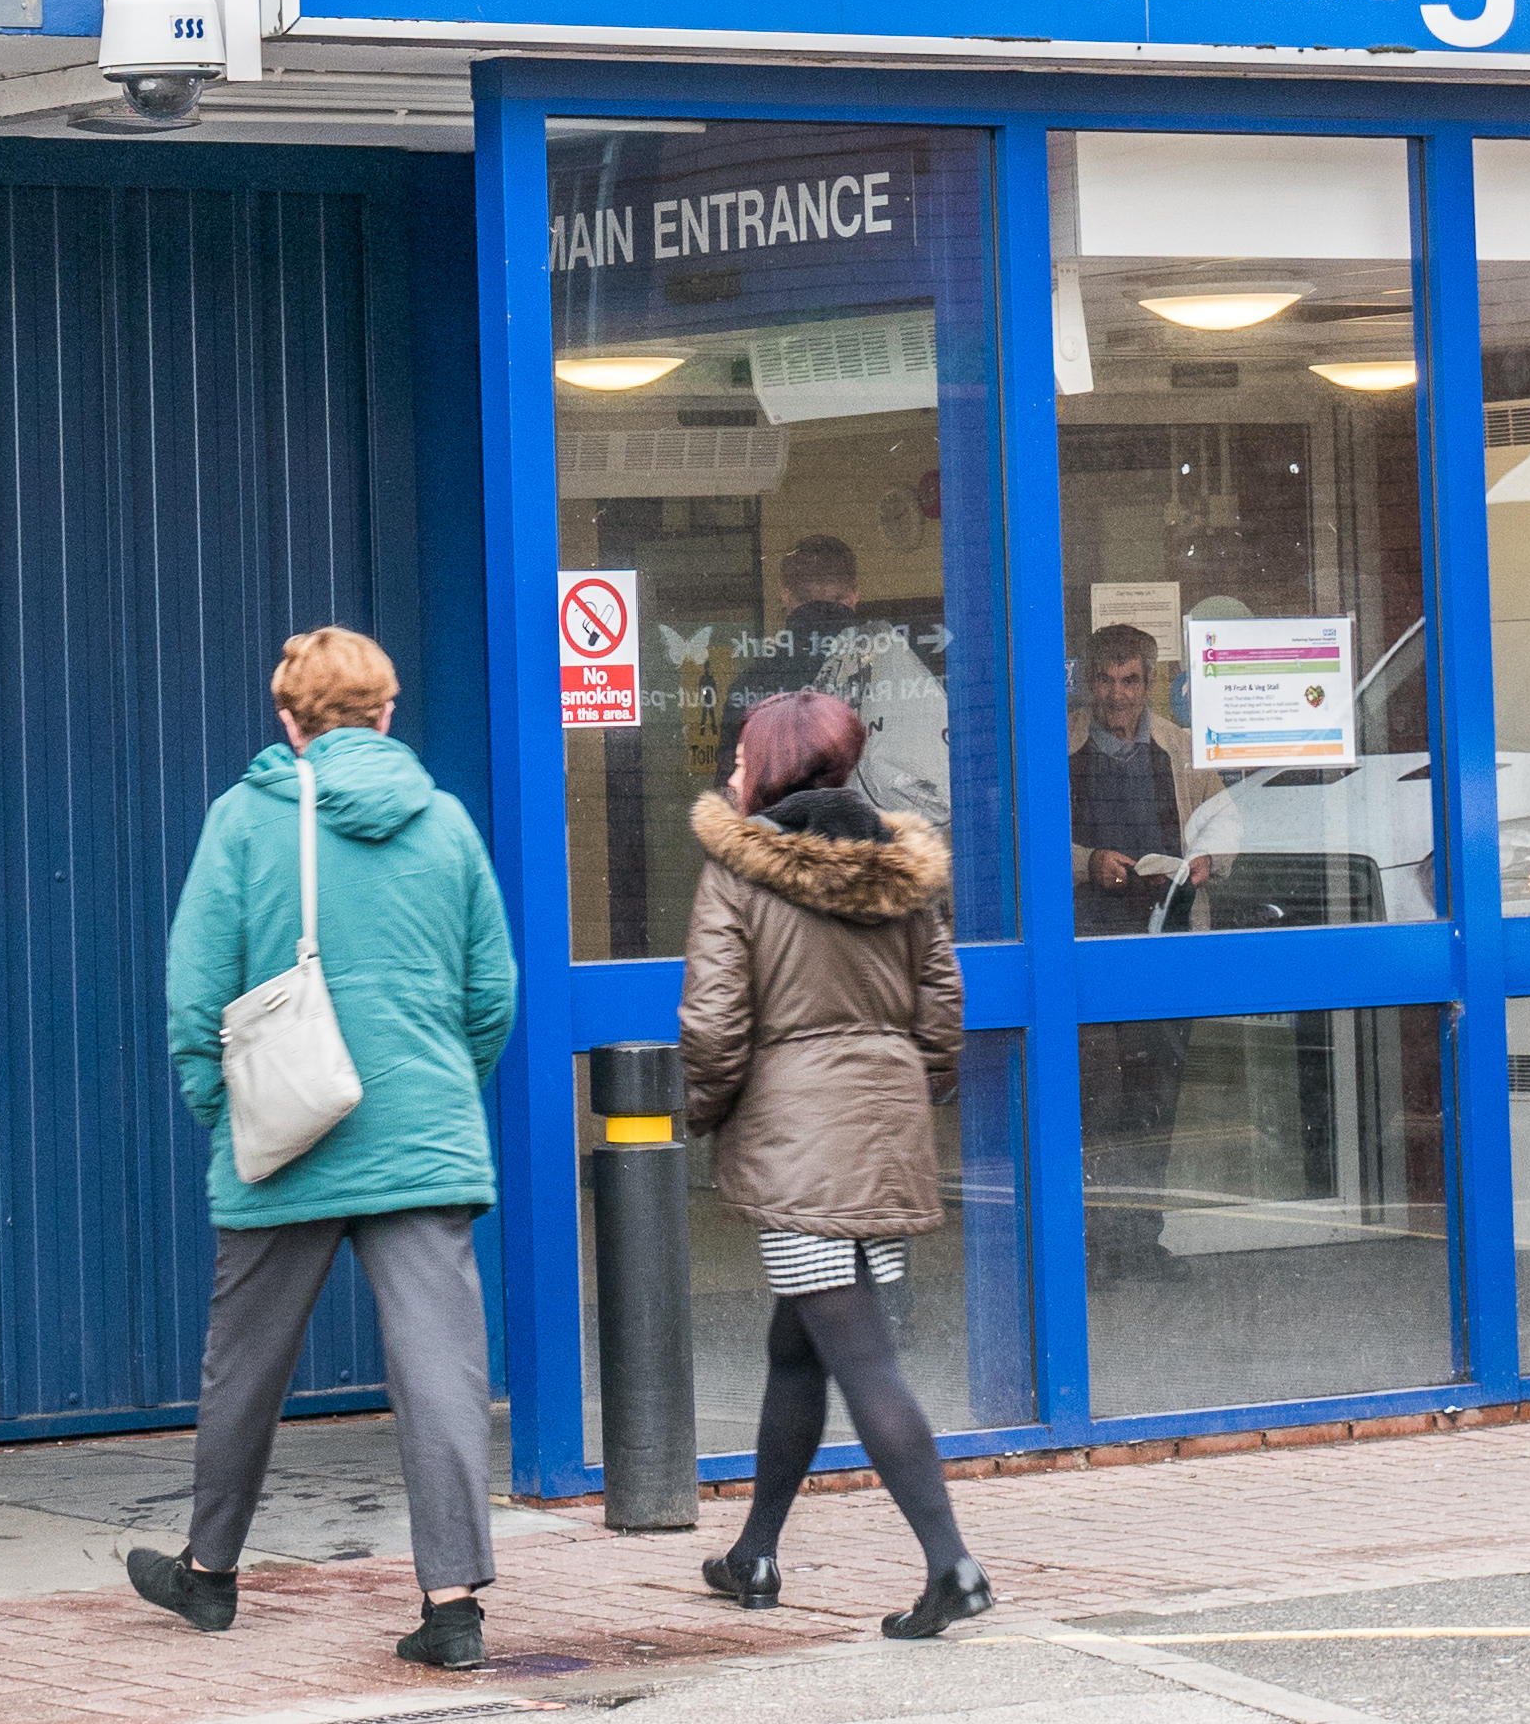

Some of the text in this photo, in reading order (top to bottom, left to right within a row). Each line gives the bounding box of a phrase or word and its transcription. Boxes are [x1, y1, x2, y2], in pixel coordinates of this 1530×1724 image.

[653, 172, 892, 261] ENTRANCE
[582, 666, 608, 686] No
[561, 686, 633, 708] smoking
[562, 707, 633, 722] in this area.
